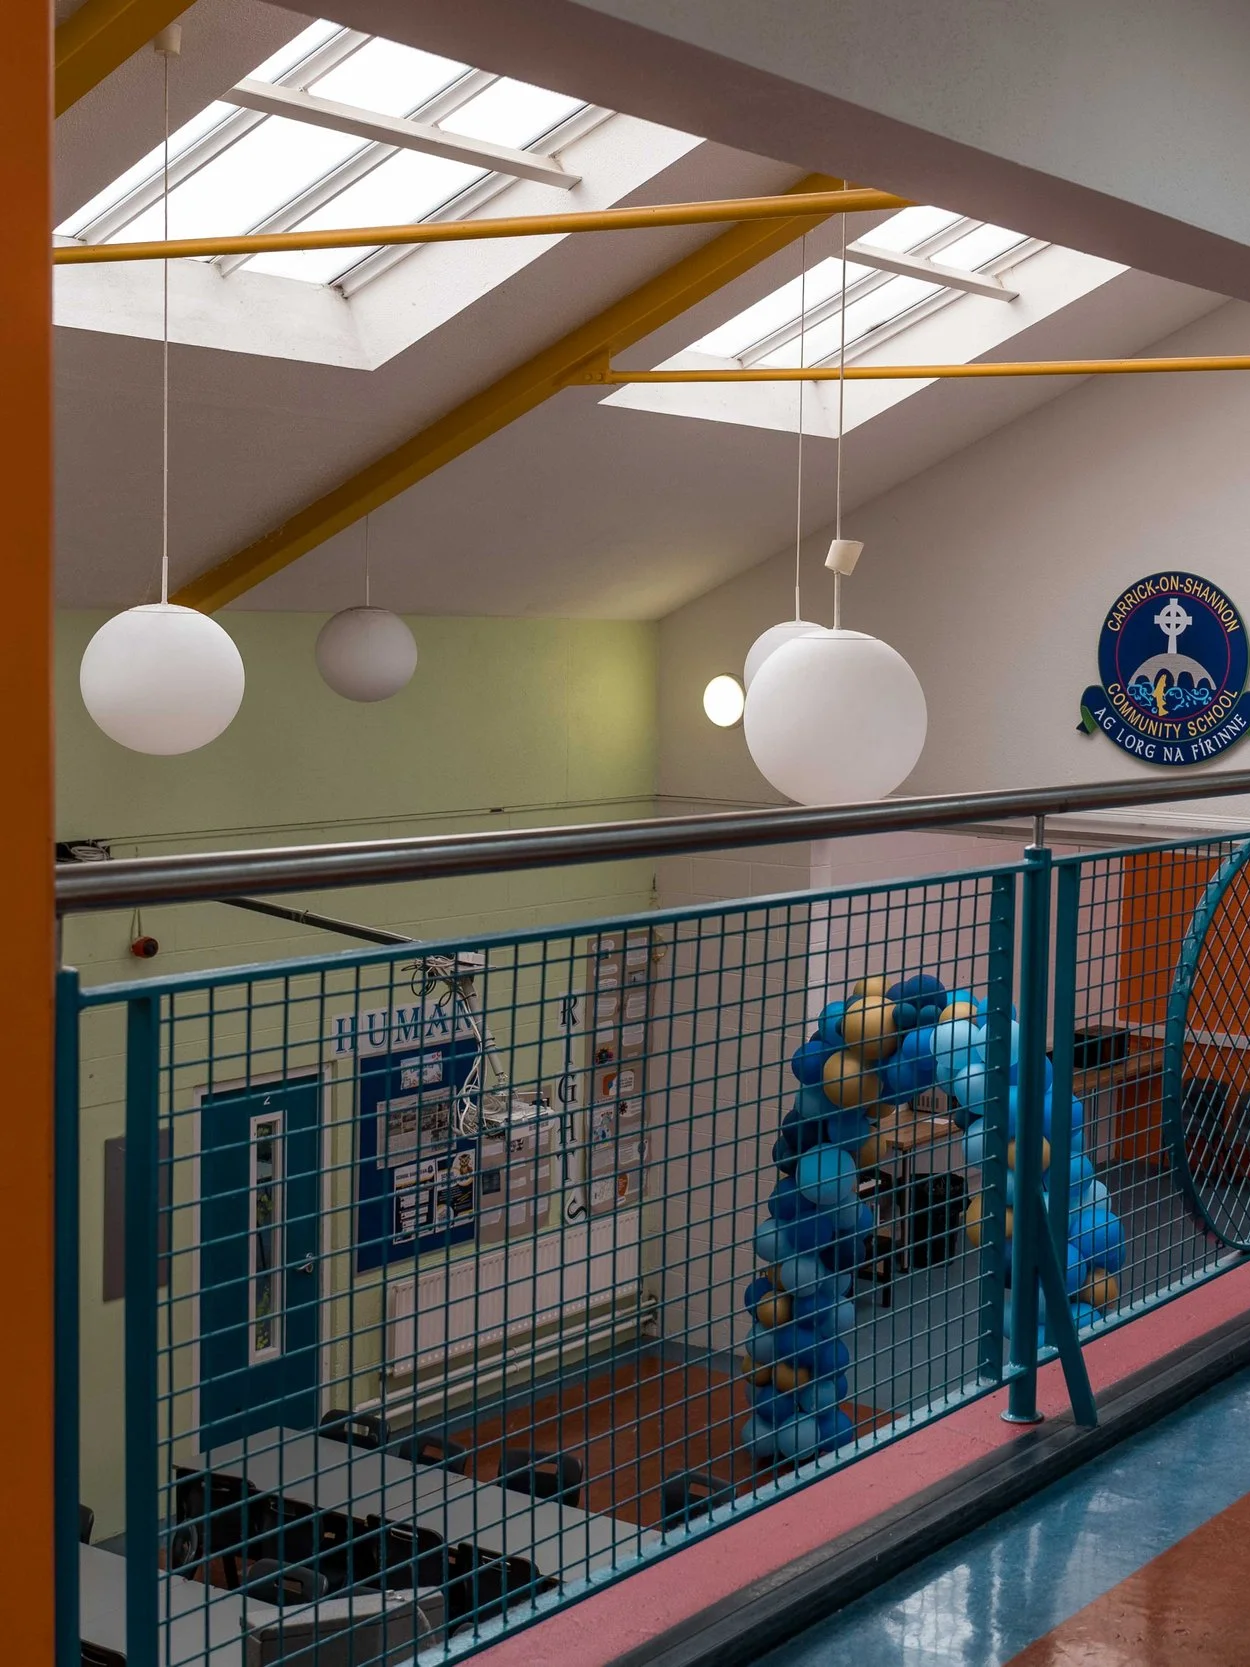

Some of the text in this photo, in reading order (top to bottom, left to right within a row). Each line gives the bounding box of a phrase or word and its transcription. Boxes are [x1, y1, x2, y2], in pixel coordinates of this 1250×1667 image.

[1107, 575, 1240, 633] CARRICK-ON-SHANNON
[1094, 707, 1247, 762] AG LORG NA FÍRINNE
[1108, 683, 1238, 739] COMMUNITY SCHOOL
[557, 994, 588, 1221] RGHTS
